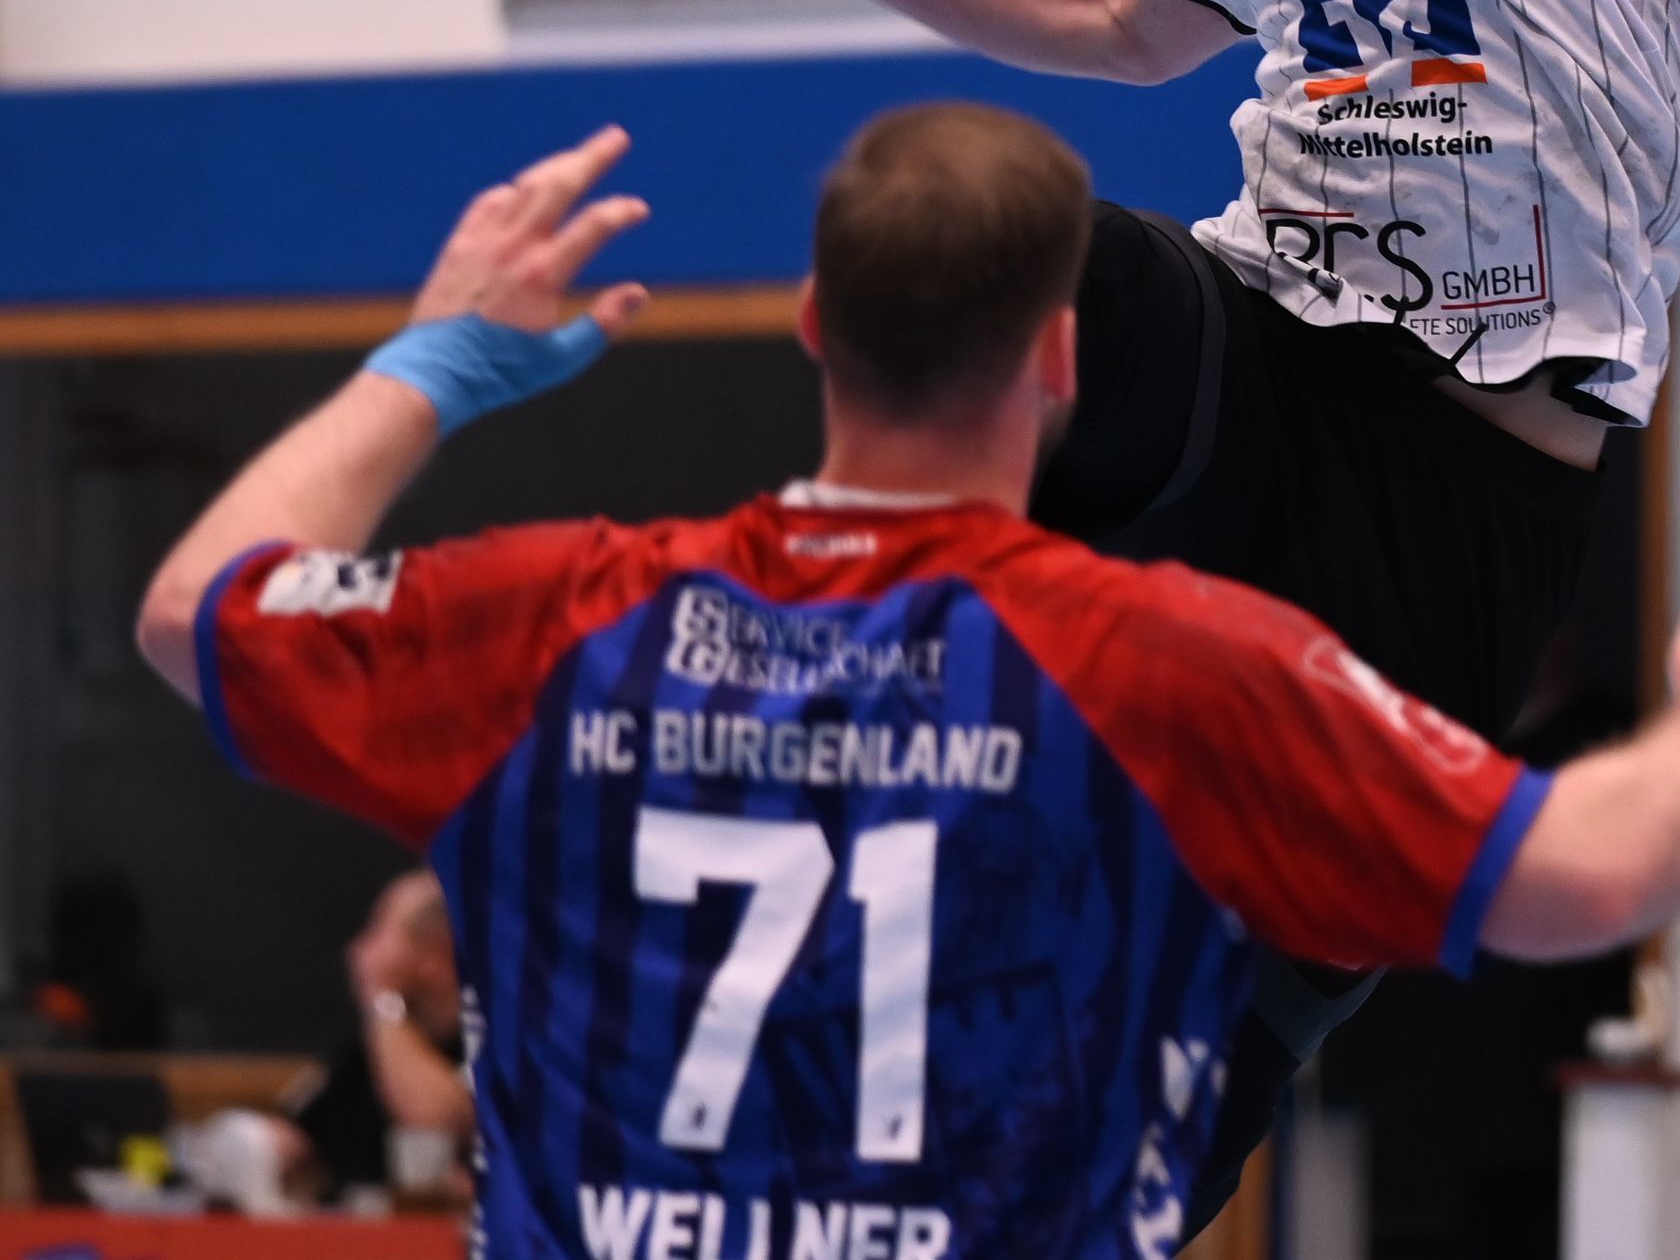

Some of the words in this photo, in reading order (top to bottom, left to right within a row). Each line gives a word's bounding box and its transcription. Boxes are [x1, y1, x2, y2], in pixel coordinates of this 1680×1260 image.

[1317, 91, 1468, 126] Schleswig-
[1297, 130, 1494, 159] Mittelholstein
[1442, 263, 1536, 301] GMBH
[1445, 309, 1542, 336] SOLUTIONS
[570, 710, 637, 774] HC
[652, 710, 1024, 794] BURGENLAND
[631, 805, 939, 1164] 71
[578, 1183, 954, 1260] WELLNER
